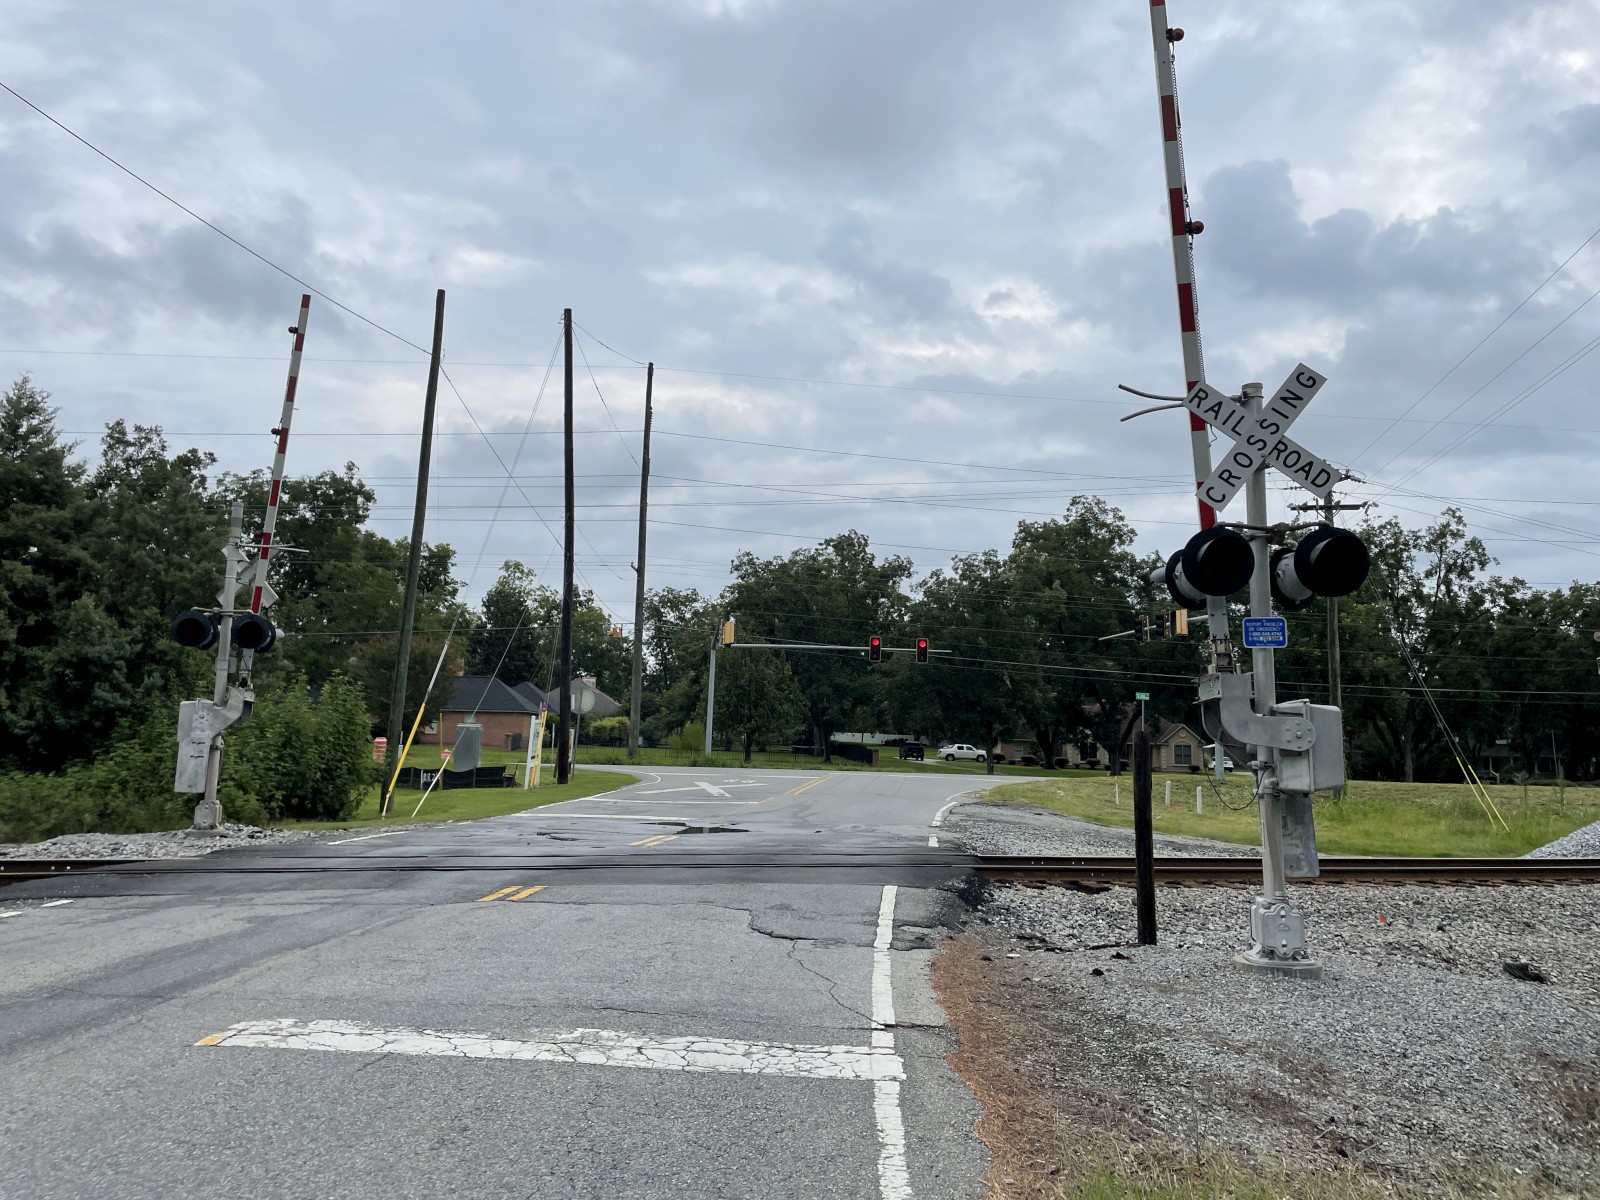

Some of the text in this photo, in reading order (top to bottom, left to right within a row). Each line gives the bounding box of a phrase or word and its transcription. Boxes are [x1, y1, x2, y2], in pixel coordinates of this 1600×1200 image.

[1188, 387, 1331, 489] RAIL ROAD
[1206, 371, 1317, 504] CROSSING
